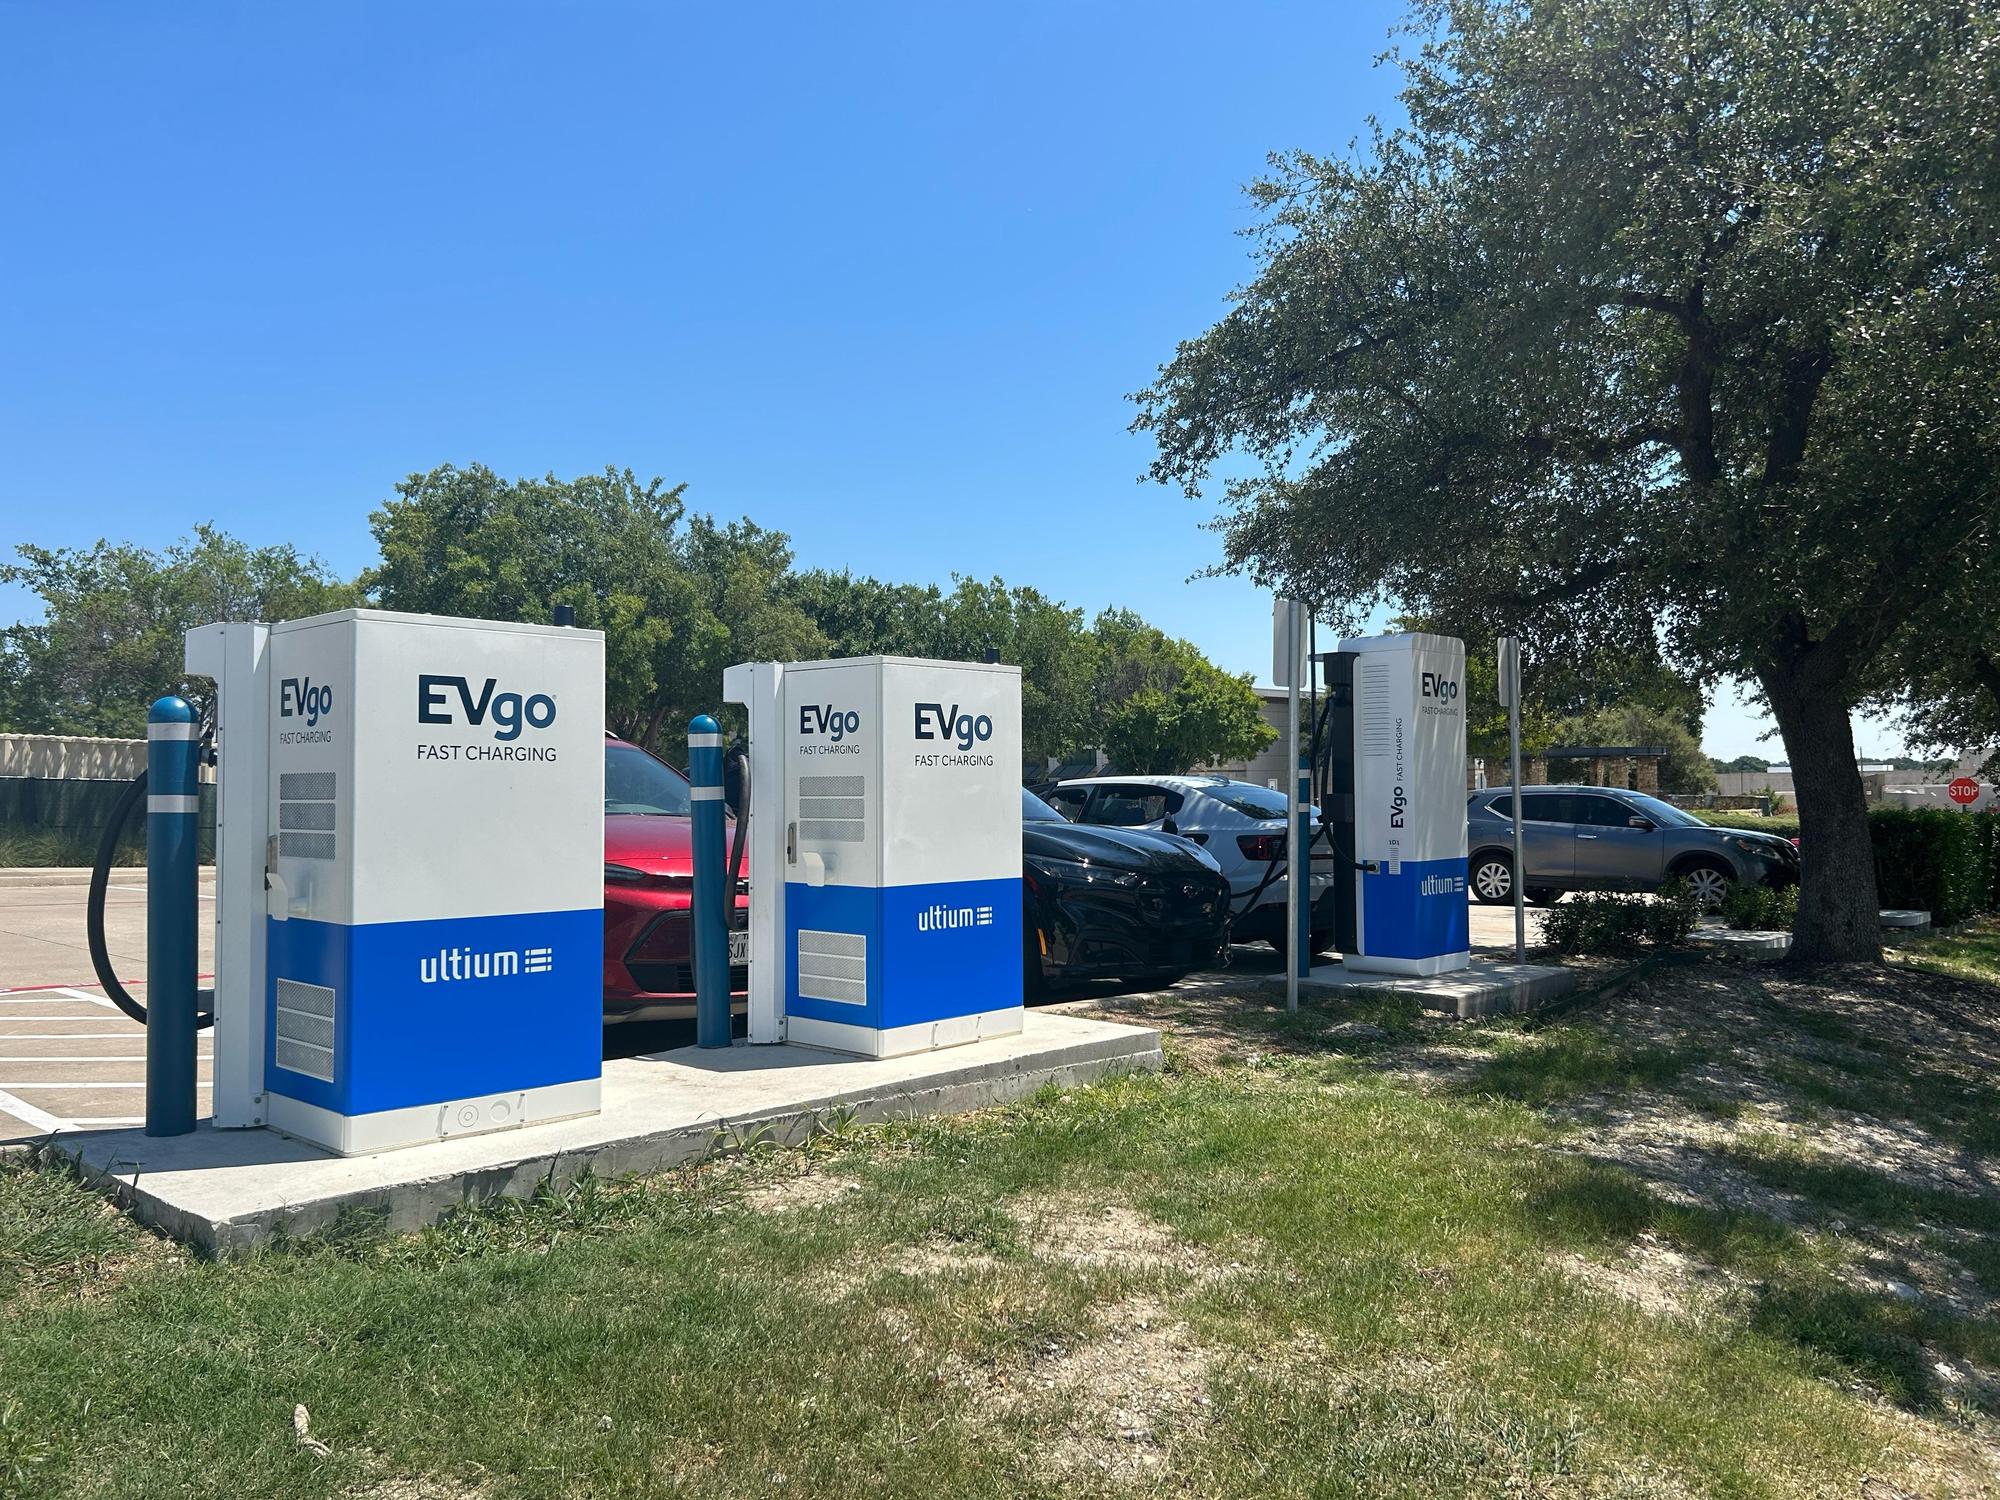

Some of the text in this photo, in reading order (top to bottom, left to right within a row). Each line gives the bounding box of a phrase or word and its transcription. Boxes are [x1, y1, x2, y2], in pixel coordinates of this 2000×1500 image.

[281, 676, 332, 727] EVgo
[1422, 672, 1457, 705] EVgo
[418, 674, 556, 741] EVgo
[800, 704, 860, 742] EVgo
[280, 730, 332, 744] FAST CHARGING
[915, 703, 993, 751] EVgo
[1395, 717, 1403, 761] CHARGING
[417, 744, 557, 762] FAST CHARGING
[800, 744, 860, 755] FAST CHARGING
[915, 754, 994, 767] FAST CHARGING
[1390, 786, 1407, 828] EVgo
[1950, 785, 1978, 796] STOP
[1421, 874, 1453, 896] ultium
[918, 904, 974, 931] ultium
[420, 946, 518, 983] ultium
